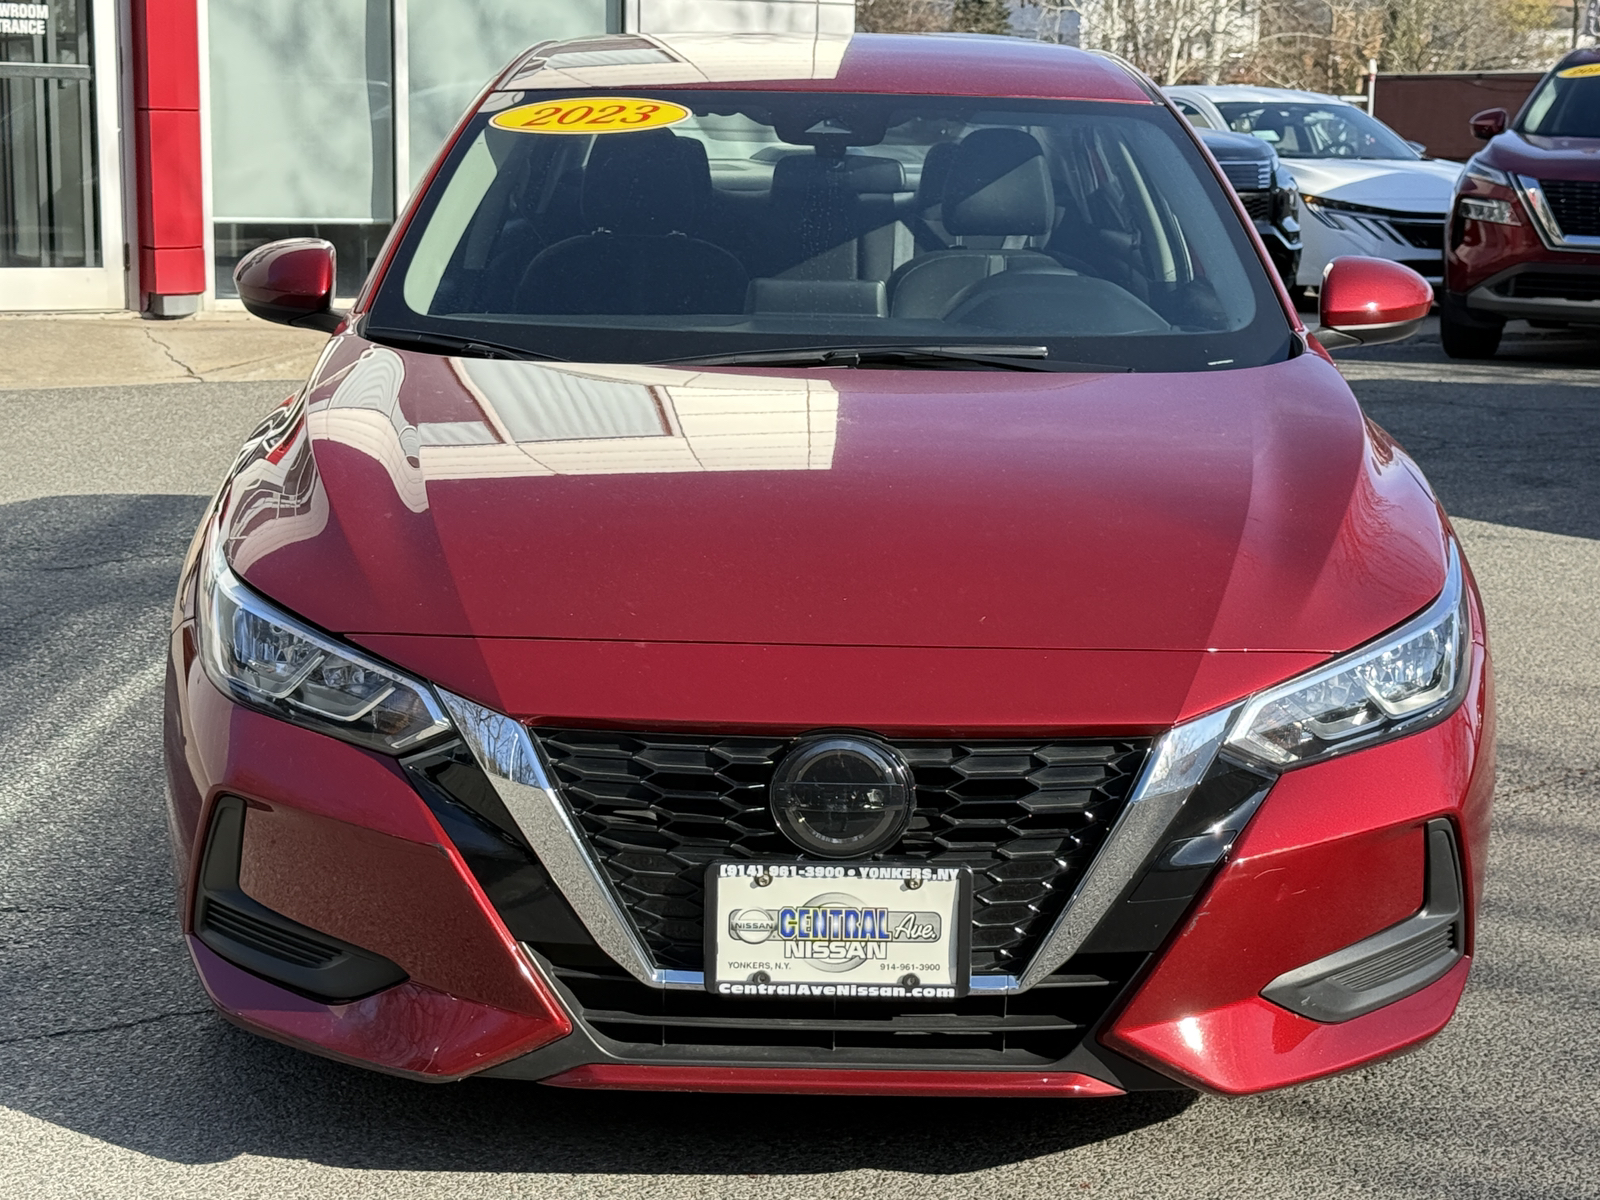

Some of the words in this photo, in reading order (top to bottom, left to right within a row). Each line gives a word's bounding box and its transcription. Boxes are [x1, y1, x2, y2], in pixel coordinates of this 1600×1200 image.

[520, 104, 661, 127] 2023
[734, 922, 774, 931] NISSAN
[778, 906, 893, 941] CENTRAL
[894, 912, 937, 939] Ave.
[784, 941, 887, 959] NISSAN
[728, 961, 773, 970] YONKERS,
[775, 962, 791, 970] N.Y.
[880, 963, 941, 971] 914-961-3900
[718, 983, 955, 998] CentralAveNissan.com
